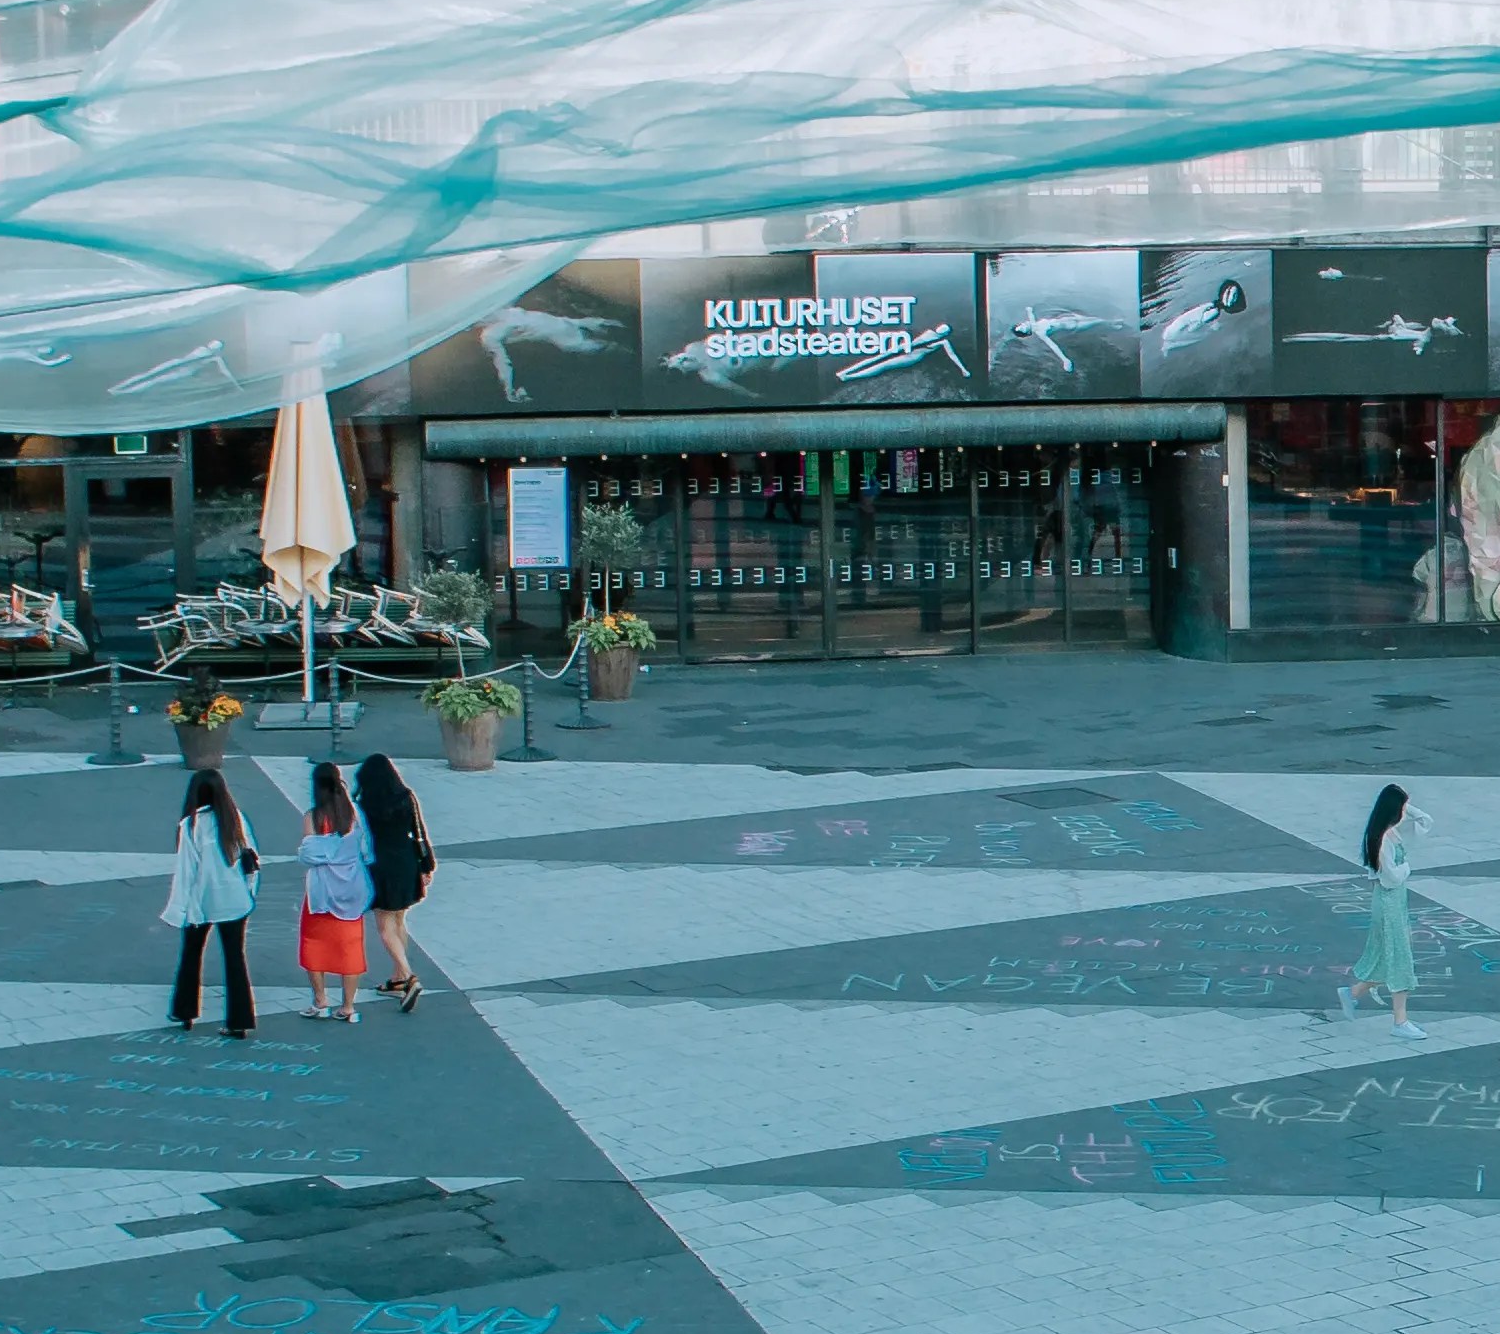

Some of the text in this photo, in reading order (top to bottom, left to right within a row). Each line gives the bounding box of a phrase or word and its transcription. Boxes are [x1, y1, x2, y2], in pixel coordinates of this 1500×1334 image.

[705, 296, 917, 328] KULTURHUSET
[706, 327, 912, 358] stadsteatern
[840, 972, 1276, 997] BE VEGAN
[1216, 1092, 1356, 1125] FÖR
[237, 1147, 372, 1163] STOP
[998, 1143, 1062, 1163] IS
[1109, 1098, 1231, 1185] FUTURE
[1057, 1131, 1138, 1186] THE
